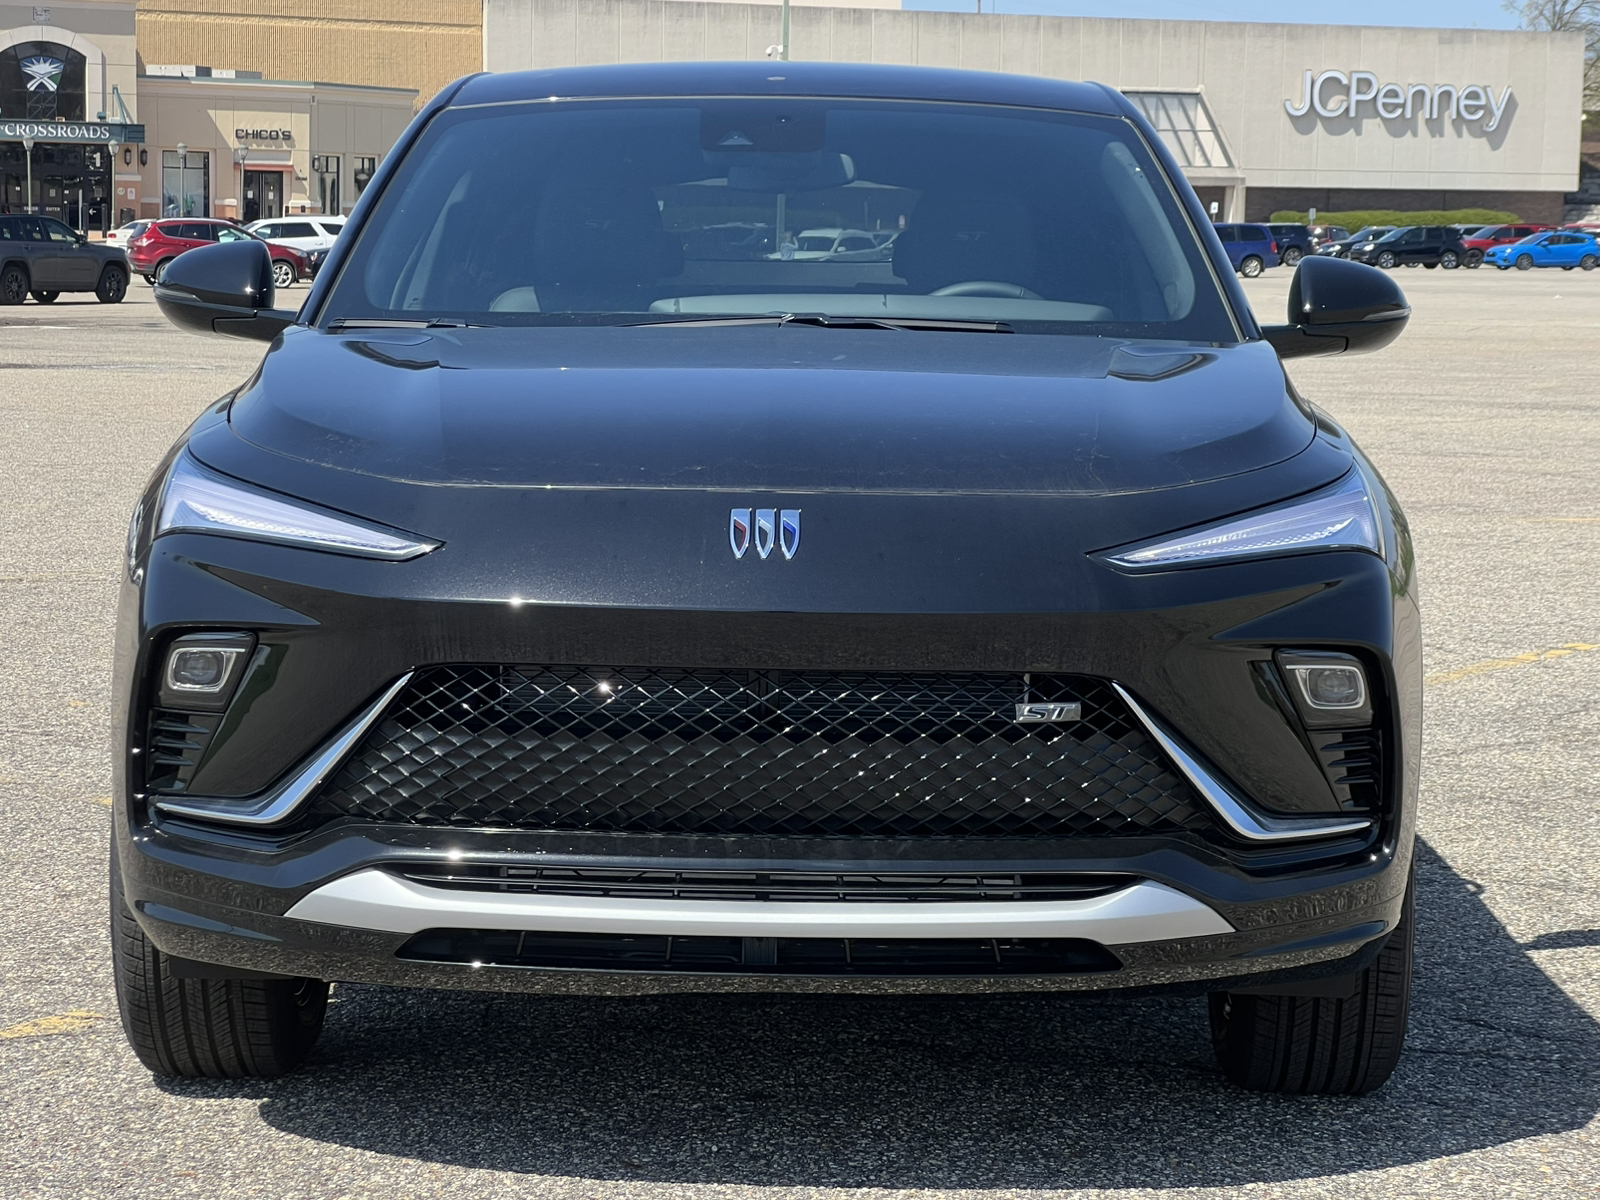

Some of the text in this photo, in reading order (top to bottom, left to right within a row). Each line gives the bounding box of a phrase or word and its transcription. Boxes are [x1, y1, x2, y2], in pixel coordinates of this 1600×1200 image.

[1285, 69, 1512, 132] JCPenney
[5, 123, 110, 139] CROSSROADS
[235, 128, 292, 141] CHICO'S
[952, 230, 988, 241] ST
[1018, 704, 1076, 721] ST
